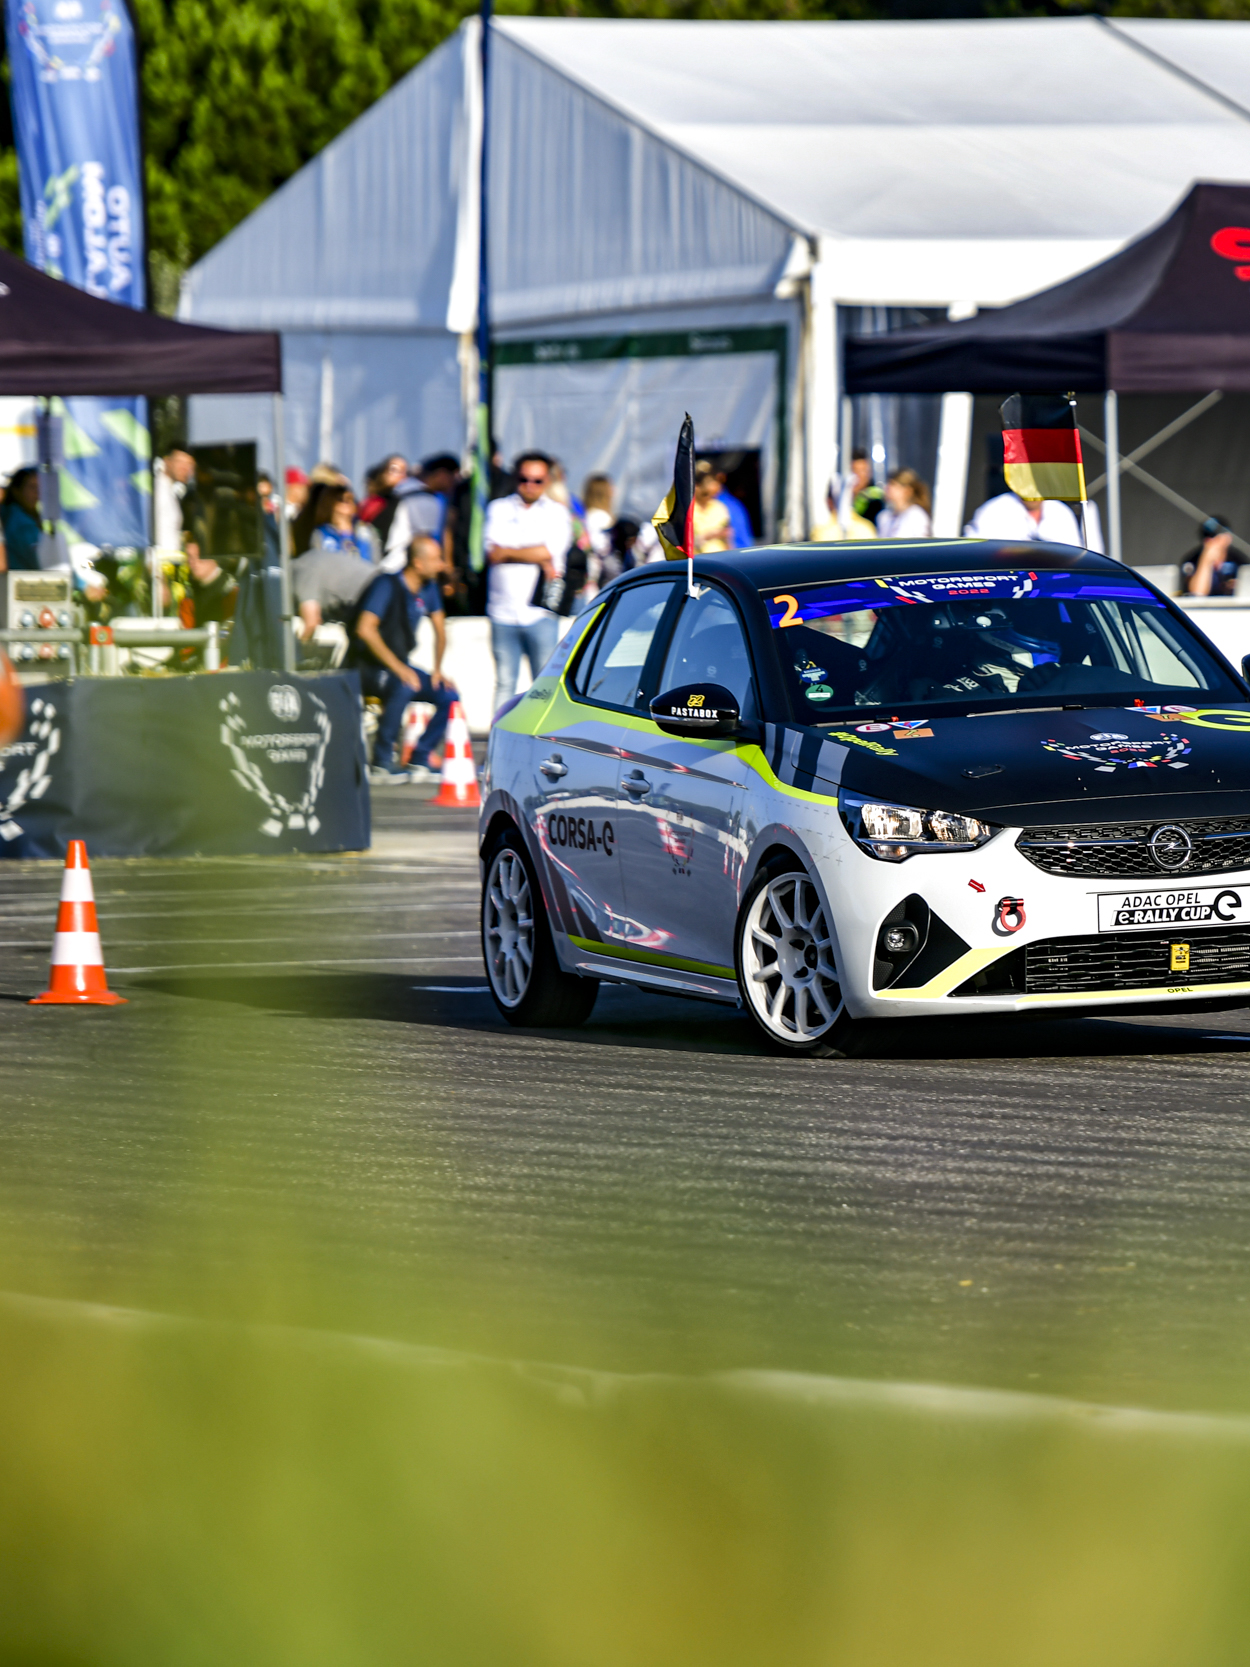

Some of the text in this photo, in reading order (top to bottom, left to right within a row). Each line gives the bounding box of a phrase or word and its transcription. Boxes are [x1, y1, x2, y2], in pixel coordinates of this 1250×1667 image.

[899, 575, 1019, 587] MOTORSPORT
[931, 581, 996, 590] GAMES
[773, 594, 804, 628] 2
[671, 706, 718, 719] PASTABOX
[1065, 741, 1172, 750] MOTORSPORT
[1096, 744, 1152, 752] GAMES
[1121, 892, 1201, 909] ADAC OPEL
[1118, 906, 1211, 924] e-RALLY CUP
